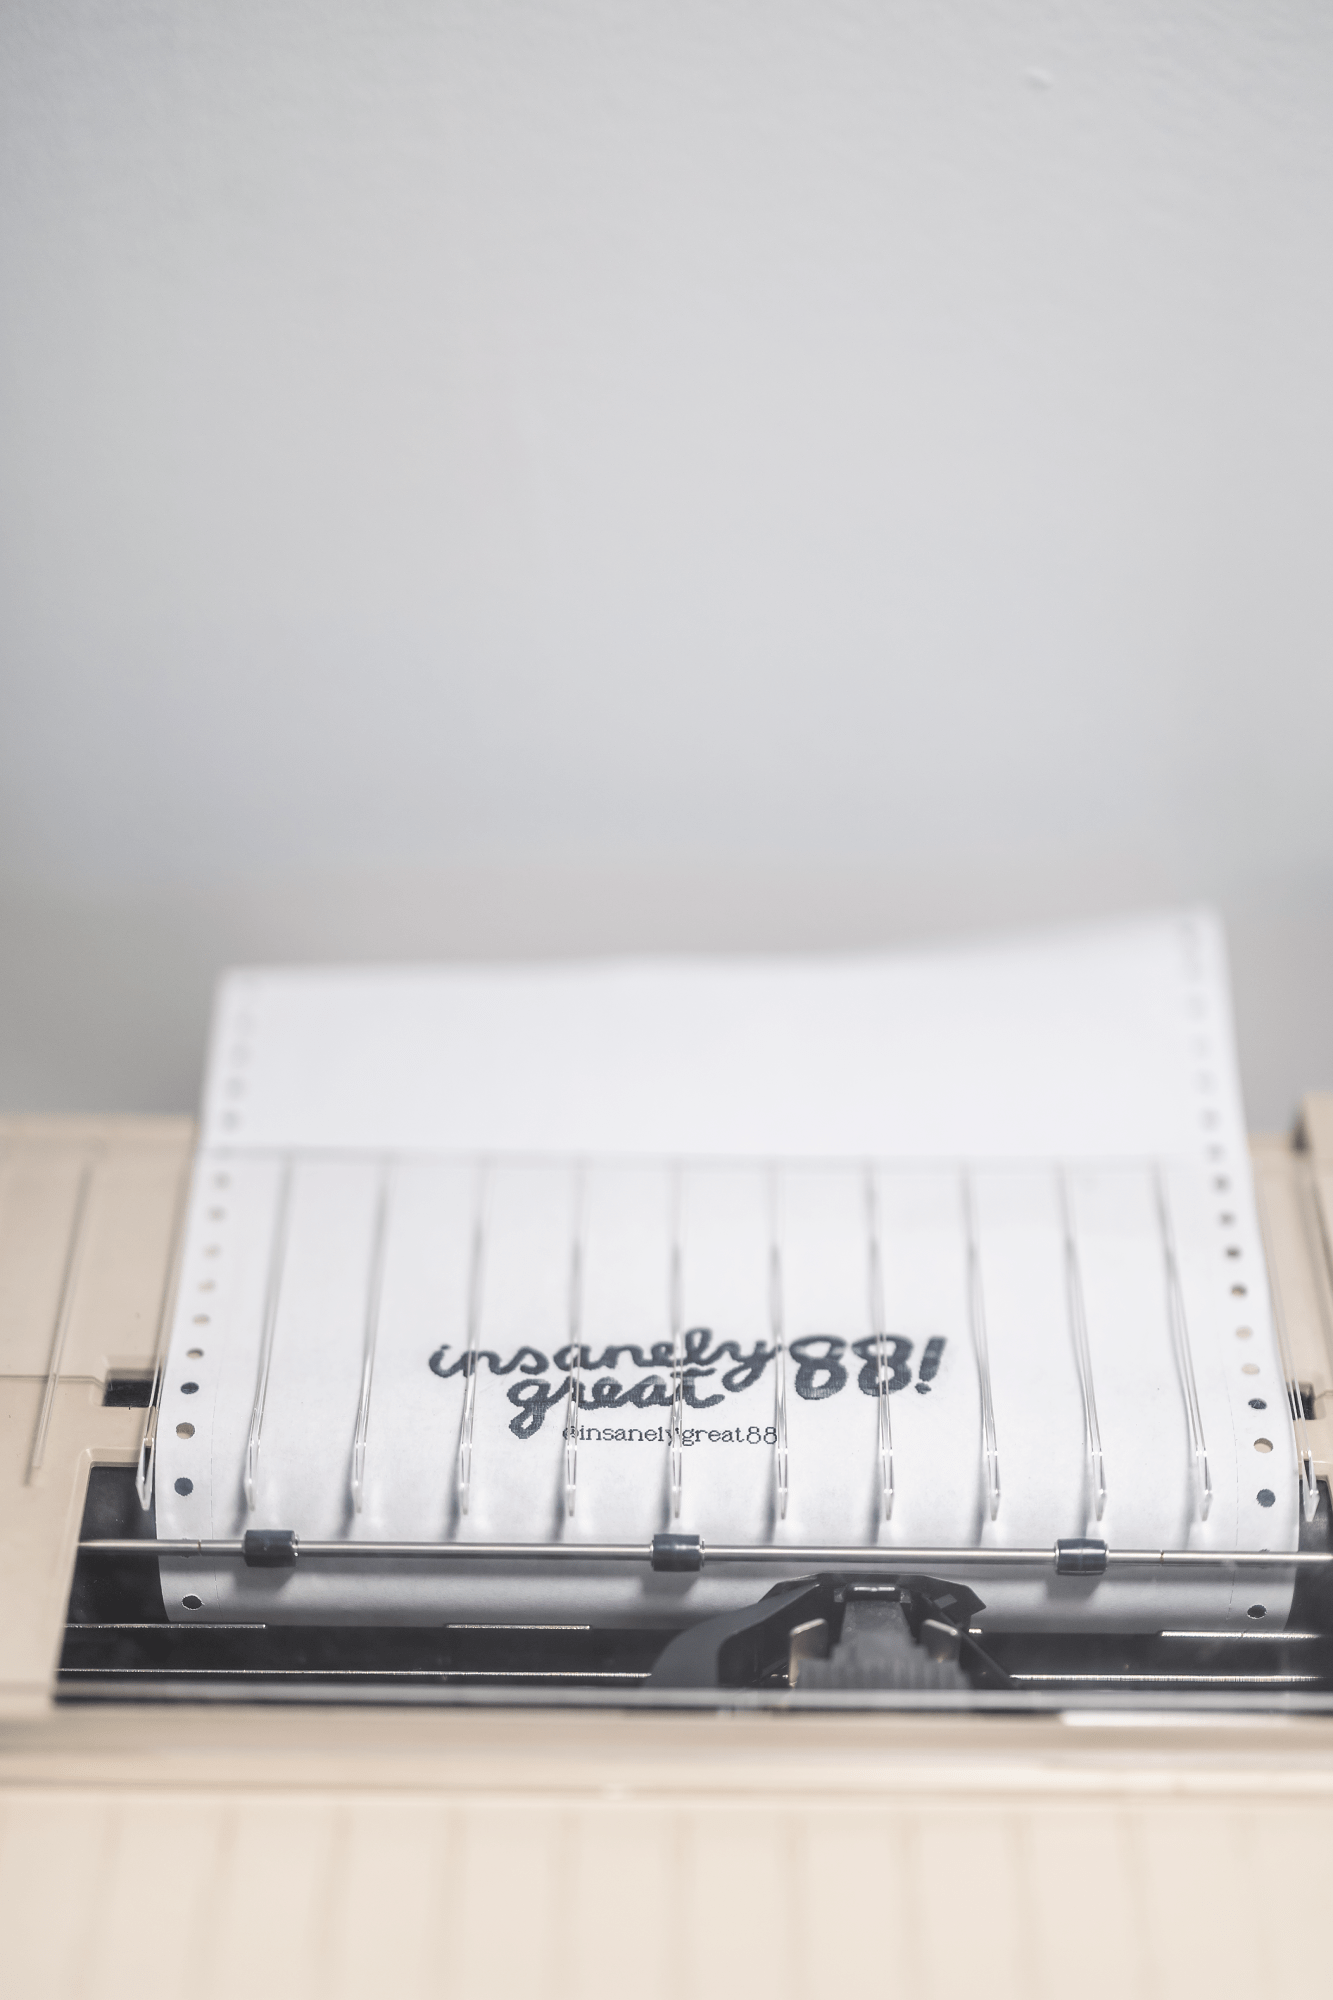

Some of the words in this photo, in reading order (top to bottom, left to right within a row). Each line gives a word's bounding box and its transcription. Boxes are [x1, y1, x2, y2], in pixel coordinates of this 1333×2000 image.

[428, 1327, 784, 1392] insanely
[789, 1334, 947, 1400] 88!
[507, 1368, 725, 1439] great
